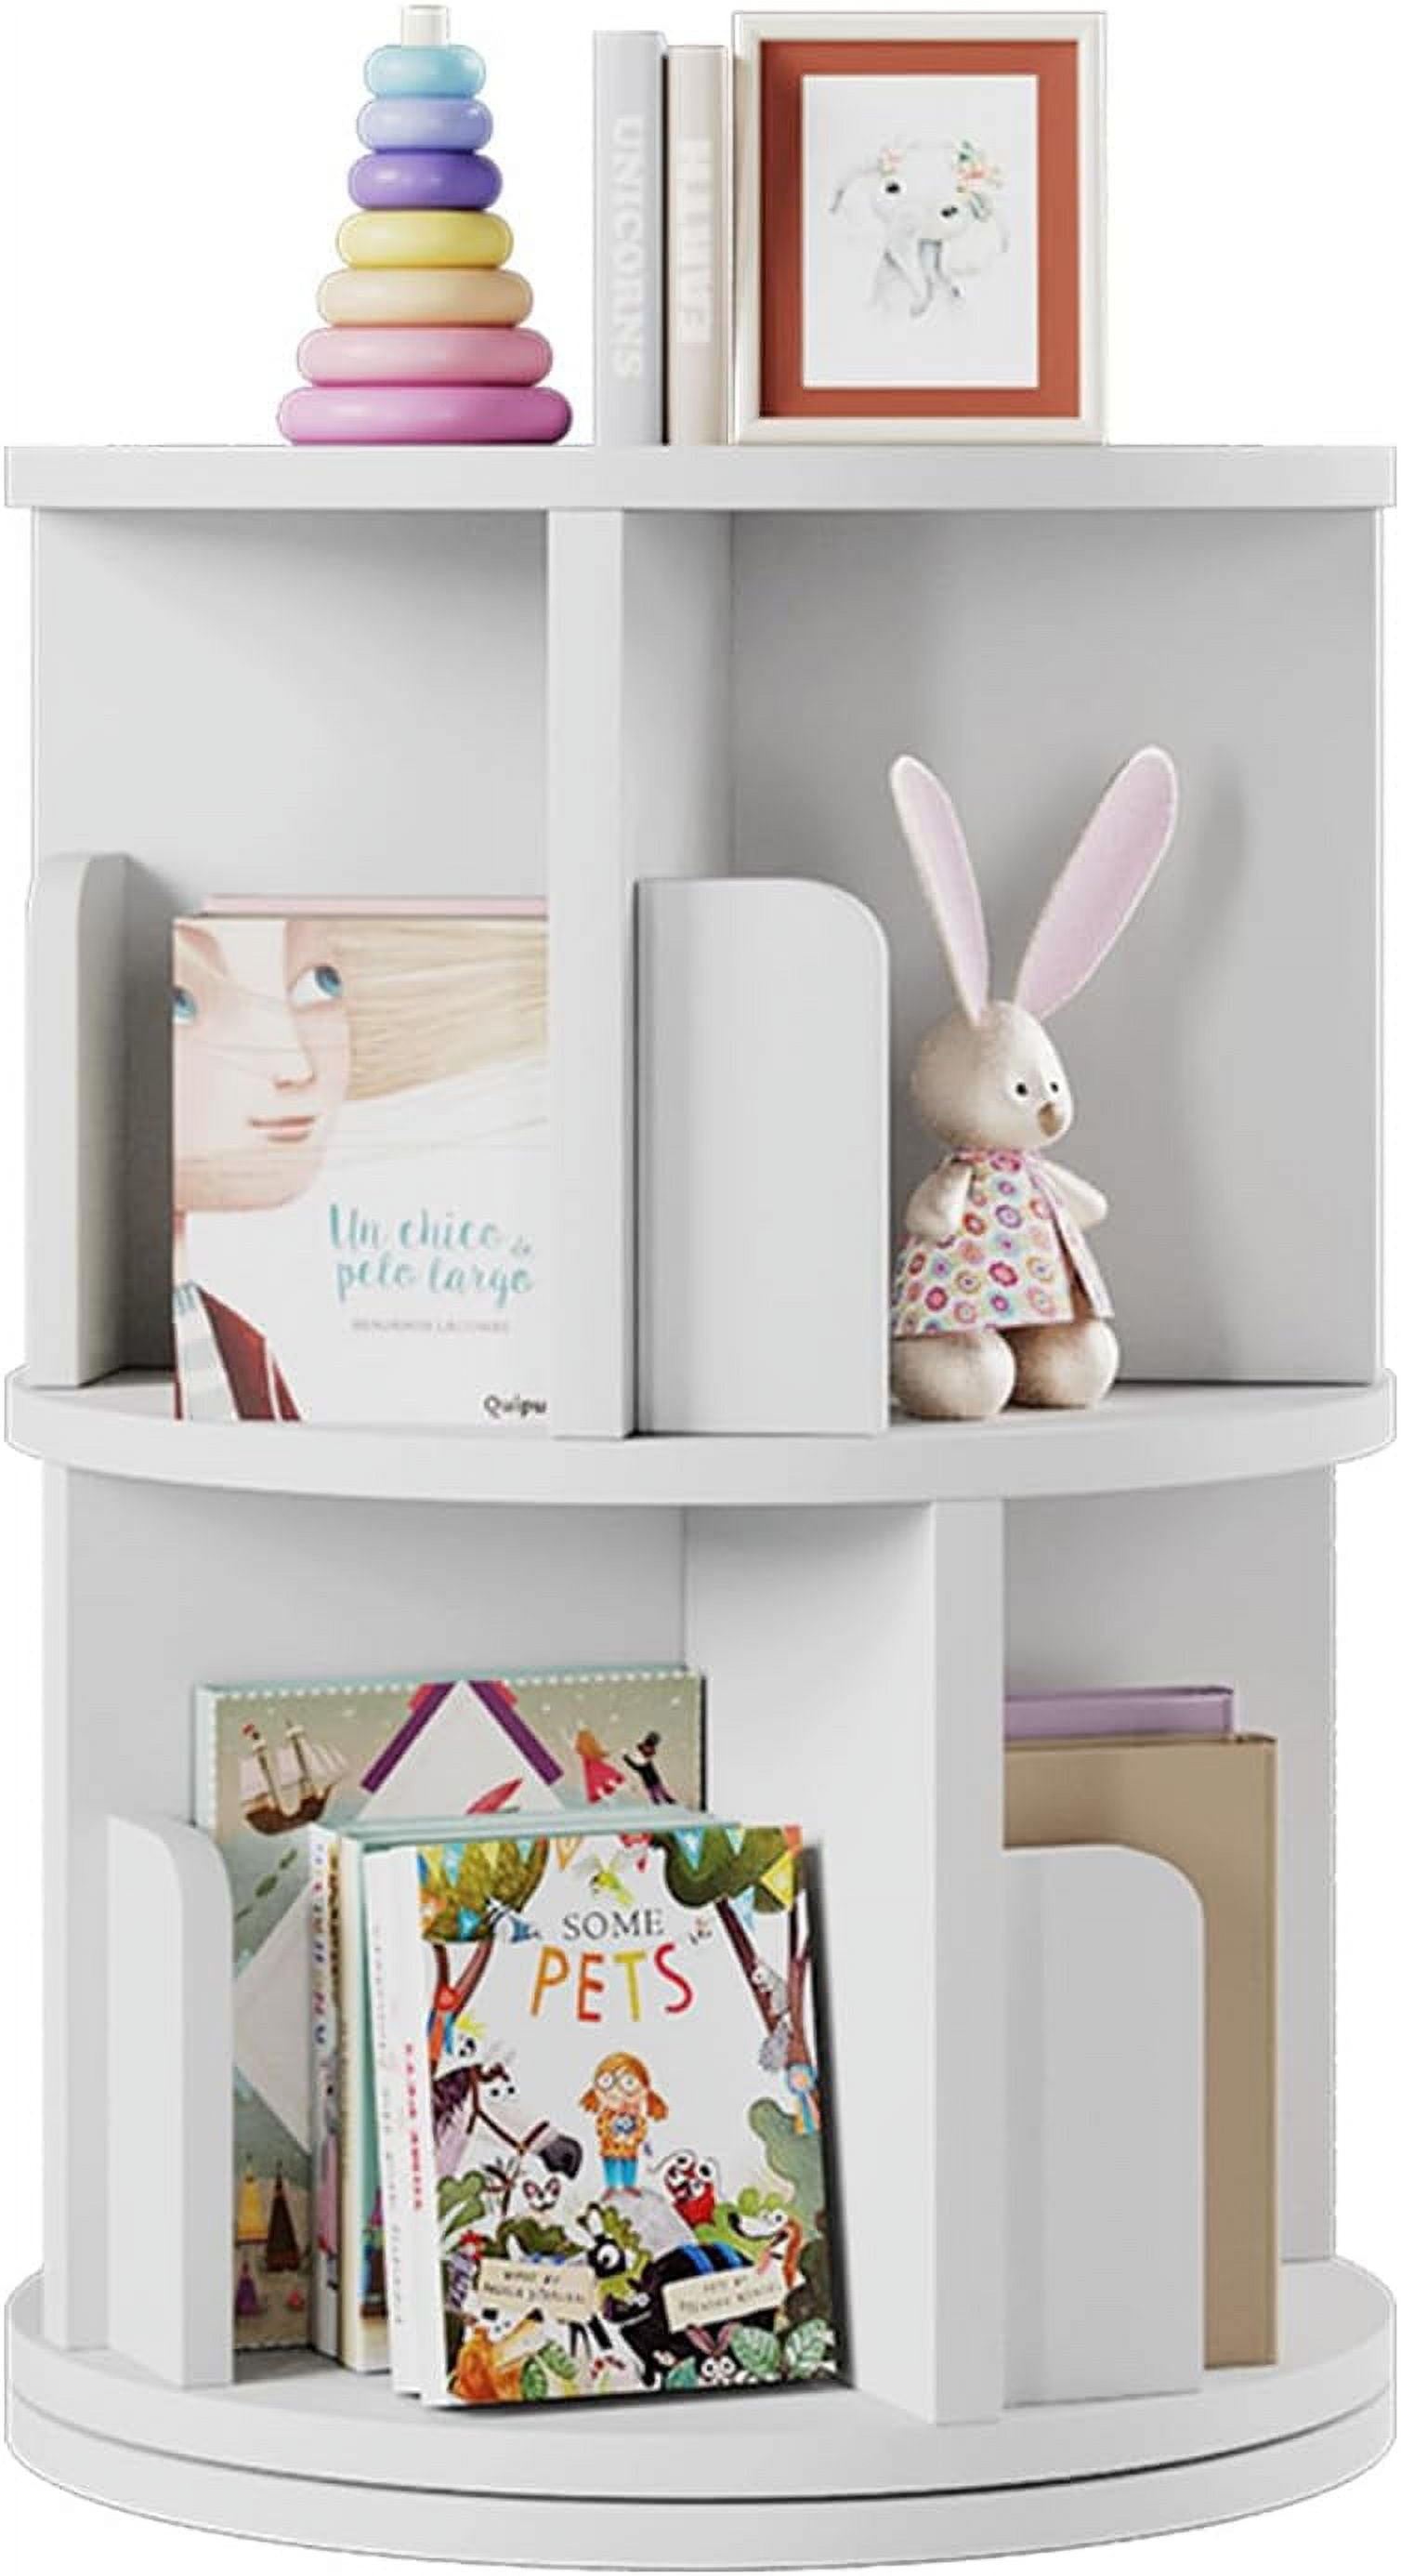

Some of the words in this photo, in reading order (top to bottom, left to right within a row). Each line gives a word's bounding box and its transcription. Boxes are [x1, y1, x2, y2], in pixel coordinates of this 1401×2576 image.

[612, 112, 646, 380] UNICORNS
[675, 138, 713, 345] EARTH
[330, 1204, 381, 1248] Un
[399, 1207, 500, 1248] chico
[336, 1251, 417, 1305] pelo
[428, 1255, 533, 1309] largo
[482, 1393, 547, 1418] Quipu
[562, 1909, 665, 1940] SOME
[530, 1943, 694, 2023] PETS
